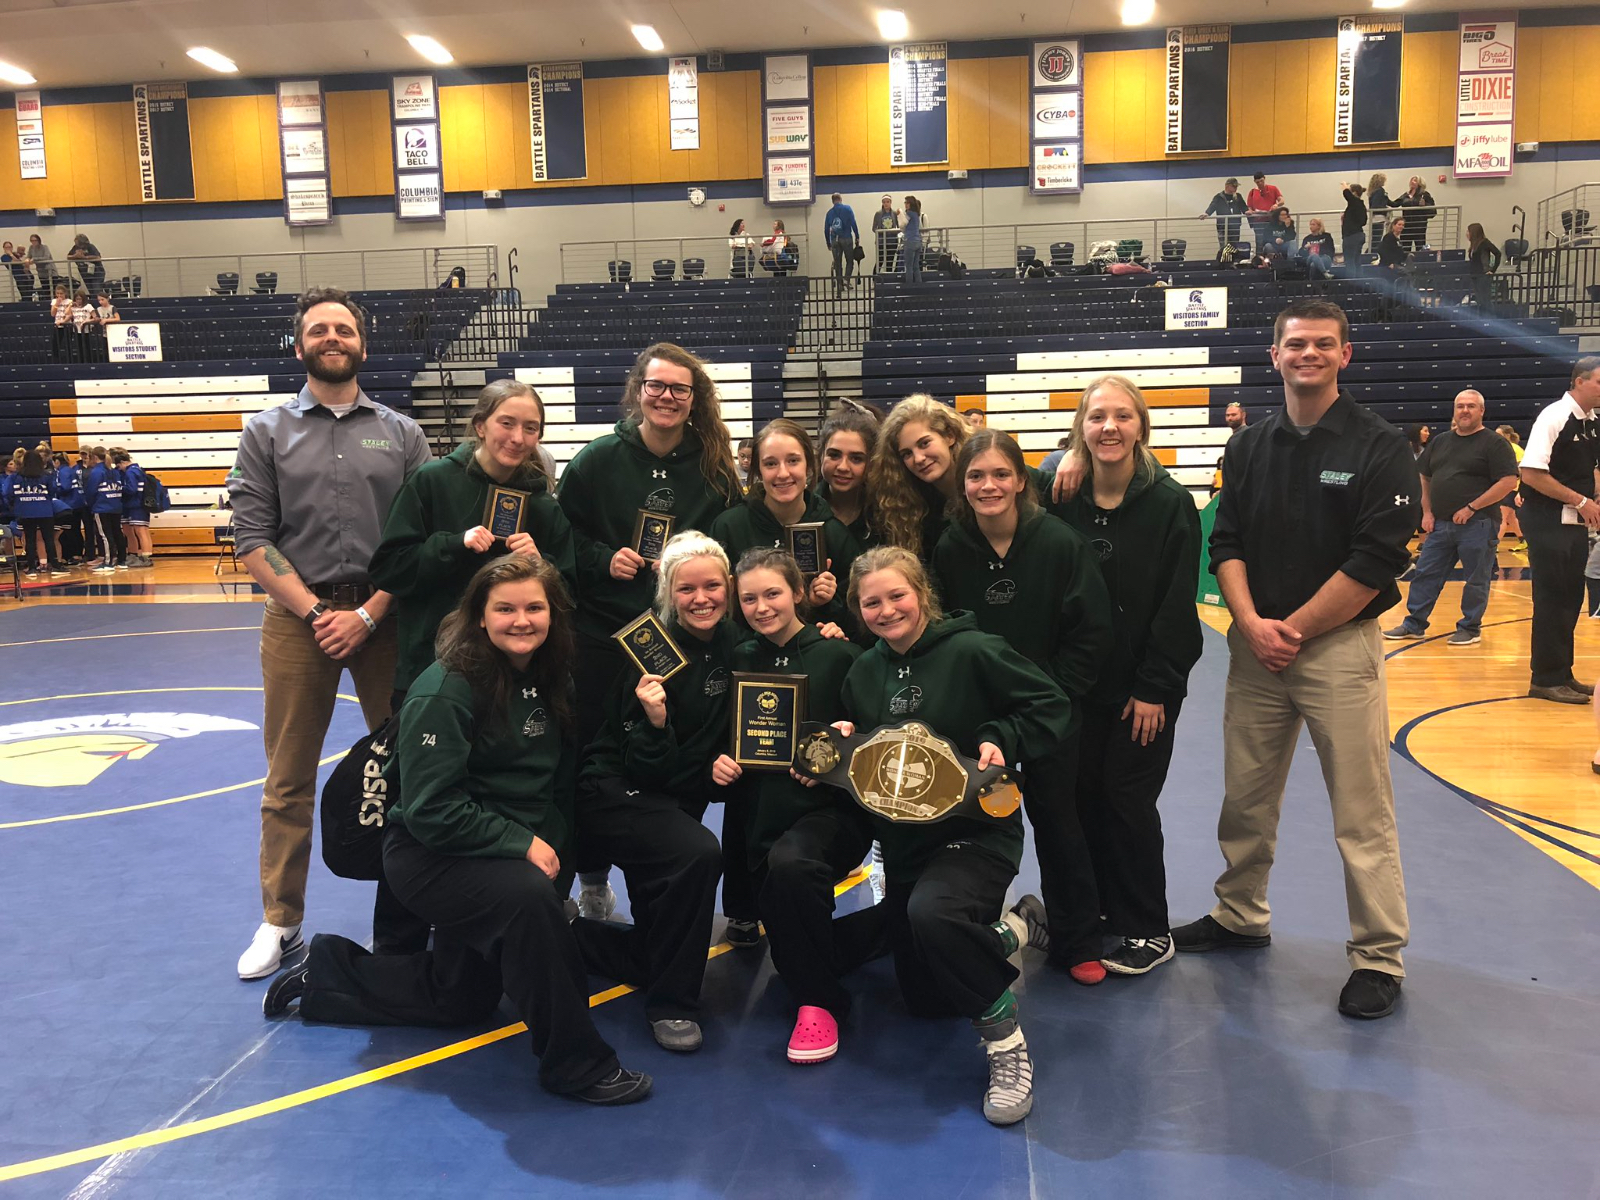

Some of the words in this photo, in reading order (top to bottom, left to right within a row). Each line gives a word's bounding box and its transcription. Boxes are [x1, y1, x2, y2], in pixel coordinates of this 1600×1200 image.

[1356, 22, 1402, 33] CHAMPIONS
[1184, 33, 1228, 44] CHAMPIONS
[905, 51, 946, 61] CHAMPIONS
[1482, 50, 1510, 62] Break
[1049, 57, 1064, 73] JJ
[1339, 48, 1350, 96] SPARTA
[543, 70, 581, 80] CHAMPIONS
[1169, 45, 1180, 105] SPARTANS
[1460, 78, 1470, 101] LITTLE
[1472, 77, 1512, 100] DIXIE
[531, 81, 542, 136] SPARTANS
[1460, 101, 1511, 111] CONSTRUCTION
[1044, 111, 1068, 119] CYBA
[1338, 101, 1349, 142] BATTLE
[137, 101, 150, 156] SPARTANS
[1168, 110, 1178, 151] BATTLE
[769, 134, 808, 143] SUBWAY
[893, 123, 902, 162] BATTLE
[534, 140, 544, 178] BATTLE
[1457, 158, 1482, 168] MFA
[1490, 157, 1508, 167] OIL
[142, 160, 153, 199] BATTLE
[401, 187, 438, 197] COLUMBIA
[1320, 470, 1355, 480] STALEY
[422, 733, 437, 747] 74
[880, 798, 919, 813] CHAMPION
